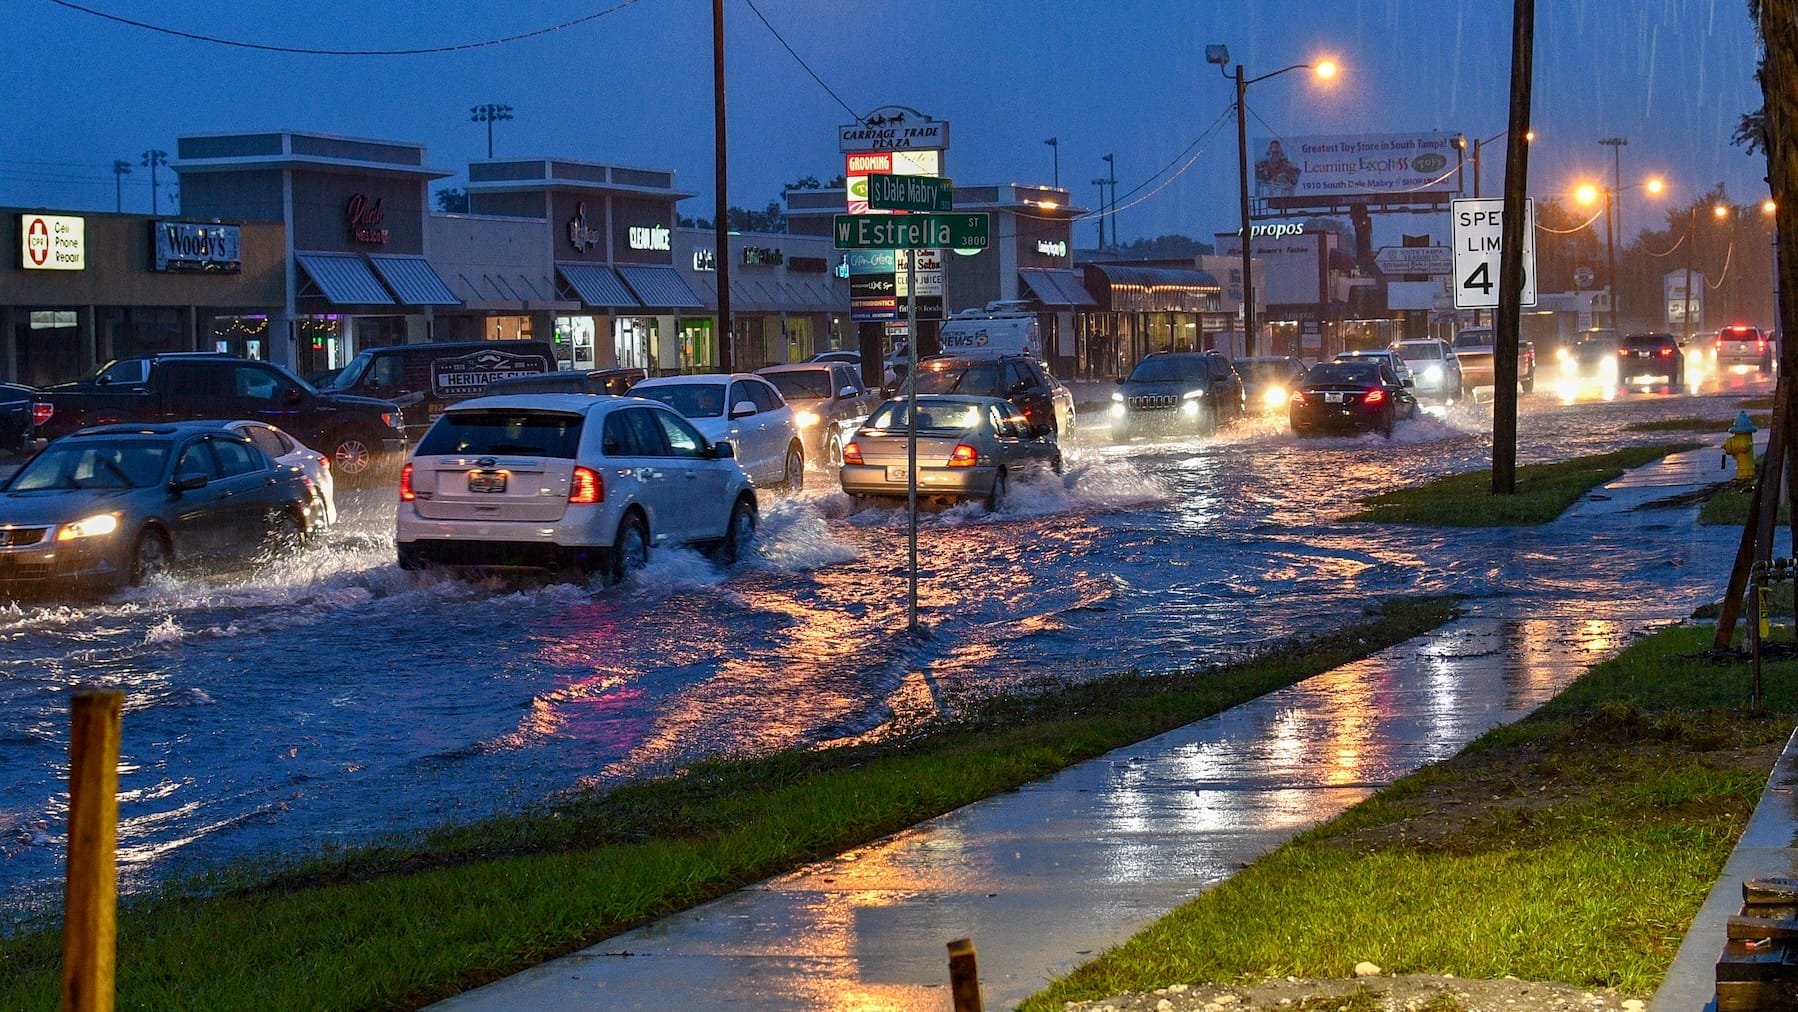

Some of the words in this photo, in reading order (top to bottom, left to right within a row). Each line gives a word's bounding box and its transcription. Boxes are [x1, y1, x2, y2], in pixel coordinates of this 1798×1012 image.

[843, 129, 897, 141] CARRIAGE
[904, 127, 940, 138] TRADE
[872, 138, 911, 149] PLAZA
[1302, 142, 1340, 154] Greatest
[1341, 142, 1355, 154] Toy
[1357, 141, 1379, 152] Store
[1381, 140, 1389, 150] in
[1391, 140, 1415, 151] South
[1417, 138, 1447, 150] Tampa!
[849, 156, 890, 172] GROOMING
[1304, 160, 1356, 175] Learning
[1302, 182, 1321, 190] 1910
[1322, 181, 1346, 190] South
[1348, 180, 1366, 189] Dale
[1367, 178, 1394, 190] Mabry
[883, 176, 905, 202] Dale
[907, 178, 938, 209] Mabry
[968, 217, 979, 227] ST
[1460, 211, 1504, 227] SPE
[55, 221, 70, 233] Cell
[839, 223, 850, 242] W
[859, 219, 951, 245] Estrella
[1238, 223, 1305, 240] propos
[55, 235, 79, 248] Phone
[166, 224, 226, 257] Woody's
[629, 227, 650, 250] CLEAN
[650, 228, 671, 251] JUICE
[962, 236, 986, 246] 3800
[1467, 236, 1500, 251] LIM
[56, 250, 80, 262] Repair
[920, 275, 942, 285] JUICE
[941, 336, 974, 347] NEWS
